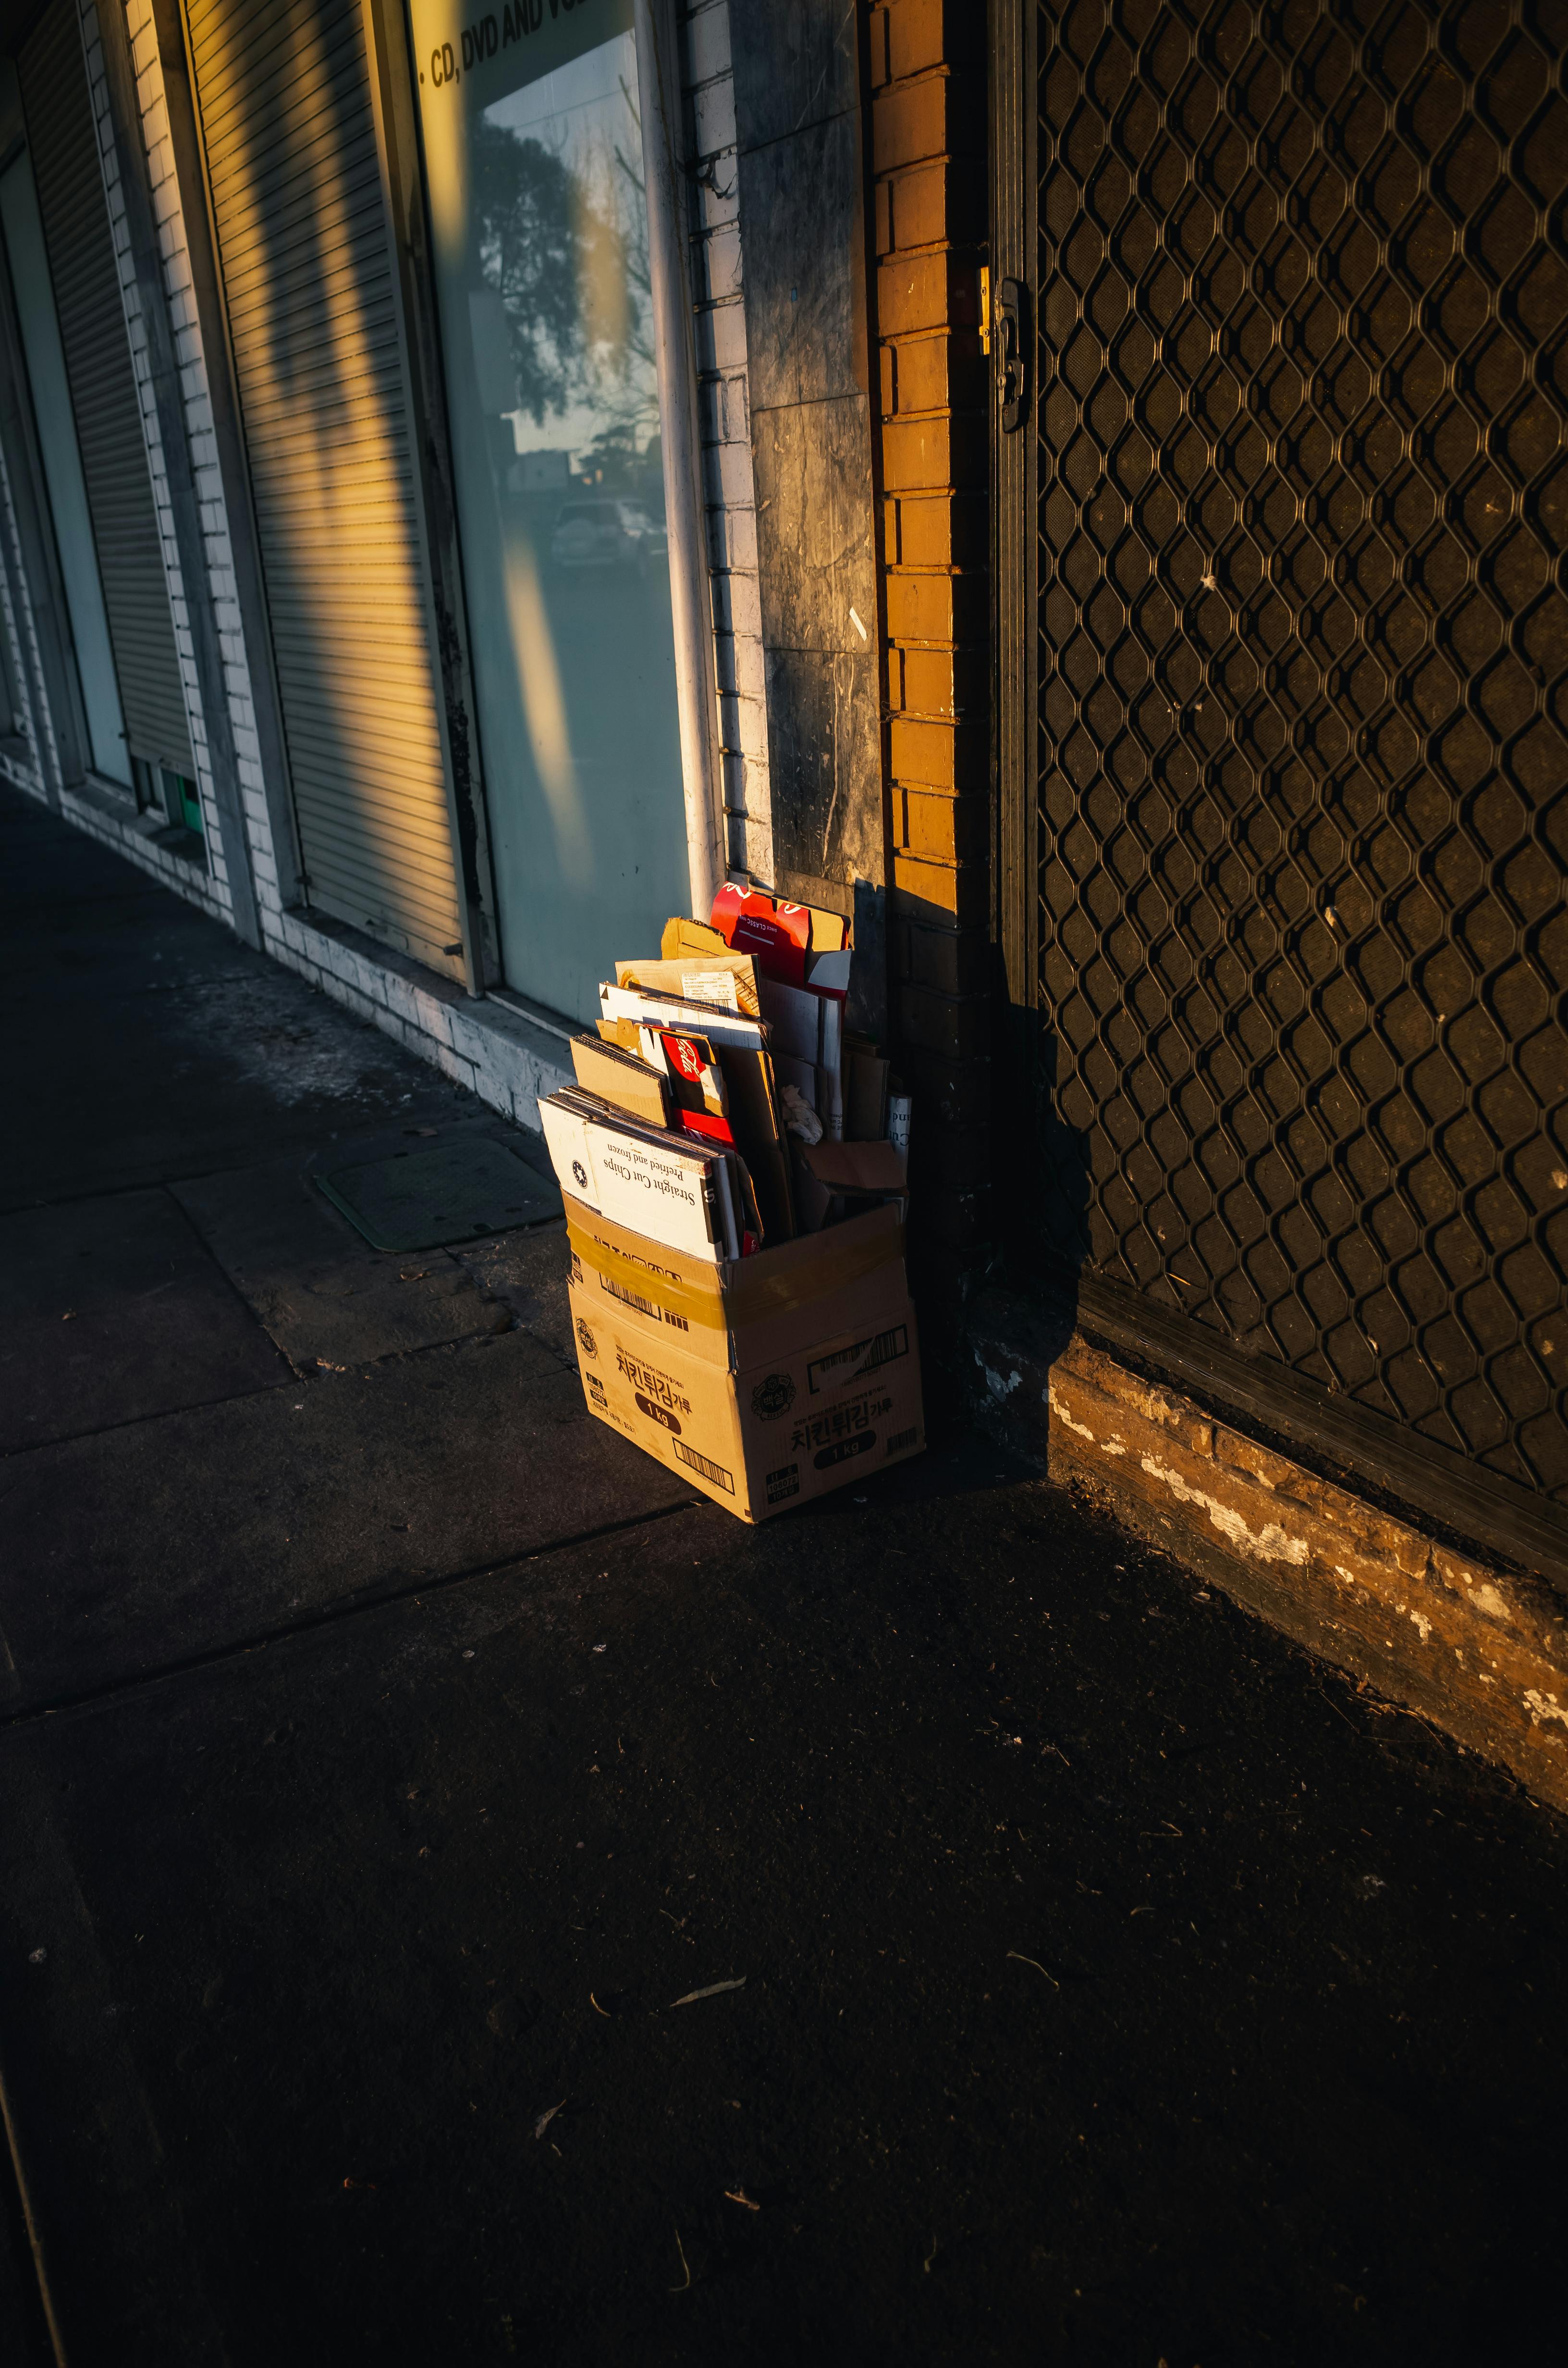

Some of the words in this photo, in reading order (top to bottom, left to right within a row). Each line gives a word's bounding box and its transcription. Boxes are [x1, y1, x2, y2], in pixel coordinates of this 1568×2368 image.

[431, 42, 460, 87] CD,
[461, 14, 498, 71] DVD
[502, 0, 542, 48] AND
[676, 1038, 700, 1077] Cola
[607, 1143, 631, 1161] frozen
[633, 1153, 648, 1165] and
[603, 1158, 631, 1180] Chips
[650, 1160, 684, 1182] Prefried
[633, 1171, 651, 1188] Cut
[654, 1179, 695, 1206] Straight
[655, 1407, 669, 1427] kg
[832, 1447, 838, 1460] 1
[844, 1442, 859, 1455] kg
[769, 1476, 796, 1492] 106072
